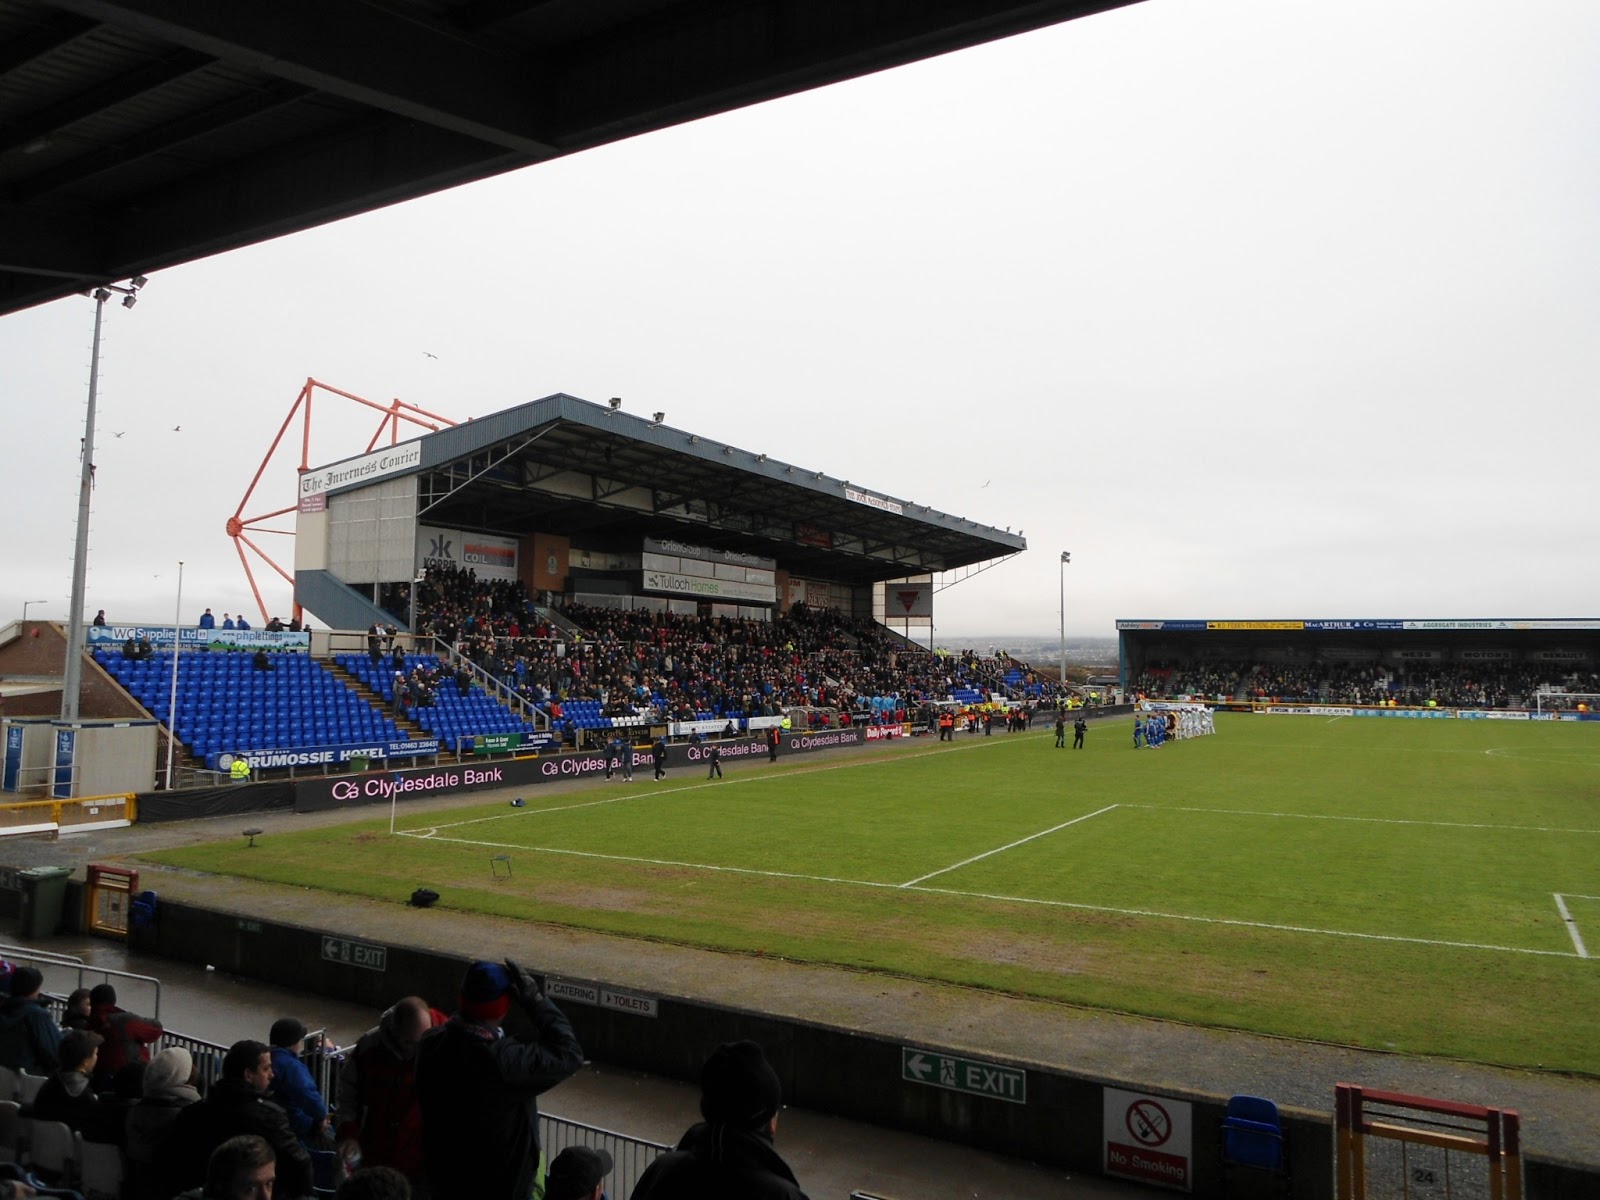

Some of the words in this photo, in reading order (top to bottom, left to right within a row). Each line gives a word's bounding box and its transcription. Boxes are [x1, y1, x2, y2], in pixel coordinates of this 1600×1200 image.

[302, 477, 322, 493] The
[325, 460, 377, 489] Inverness
[380, 450, 419, 470] Courier
[659, 574, 690, 591] Tulloch
[691, 581, 719, 594] Homes
[137, 628, 177, 641] Supplies
[181, 629, 197, 639] Ltd
[585, 730, 598, 739] The
[627, 728, 649, 736] Tavern
[801, 734, 839, 749] Clydesdale
[840, 733, 857, 743] Bank
[866, 728, 880, 739] Daily
[703, 744, 749, 758] Cesdale
[750, 742, 768, 754] Ban
[561, 757, 623, 776] Clydesa
[632, 752, 655, 766] Ban
[365, 772, 459, 799] Clydesdale
[464, 767, 503, 785] Bank
[355, 947, 383, 966] EXIT
[553, 984, 595, 1000] CATERING
[614, 995, 650, 1011] TOILETS
[966, 1066, 1020, 1096] EXIT
[1110, 1151, 1127, 1165] No
[1131, 1155, 1185, 1180] Smoking
[1415, 1170, 1434, 1184] 24
